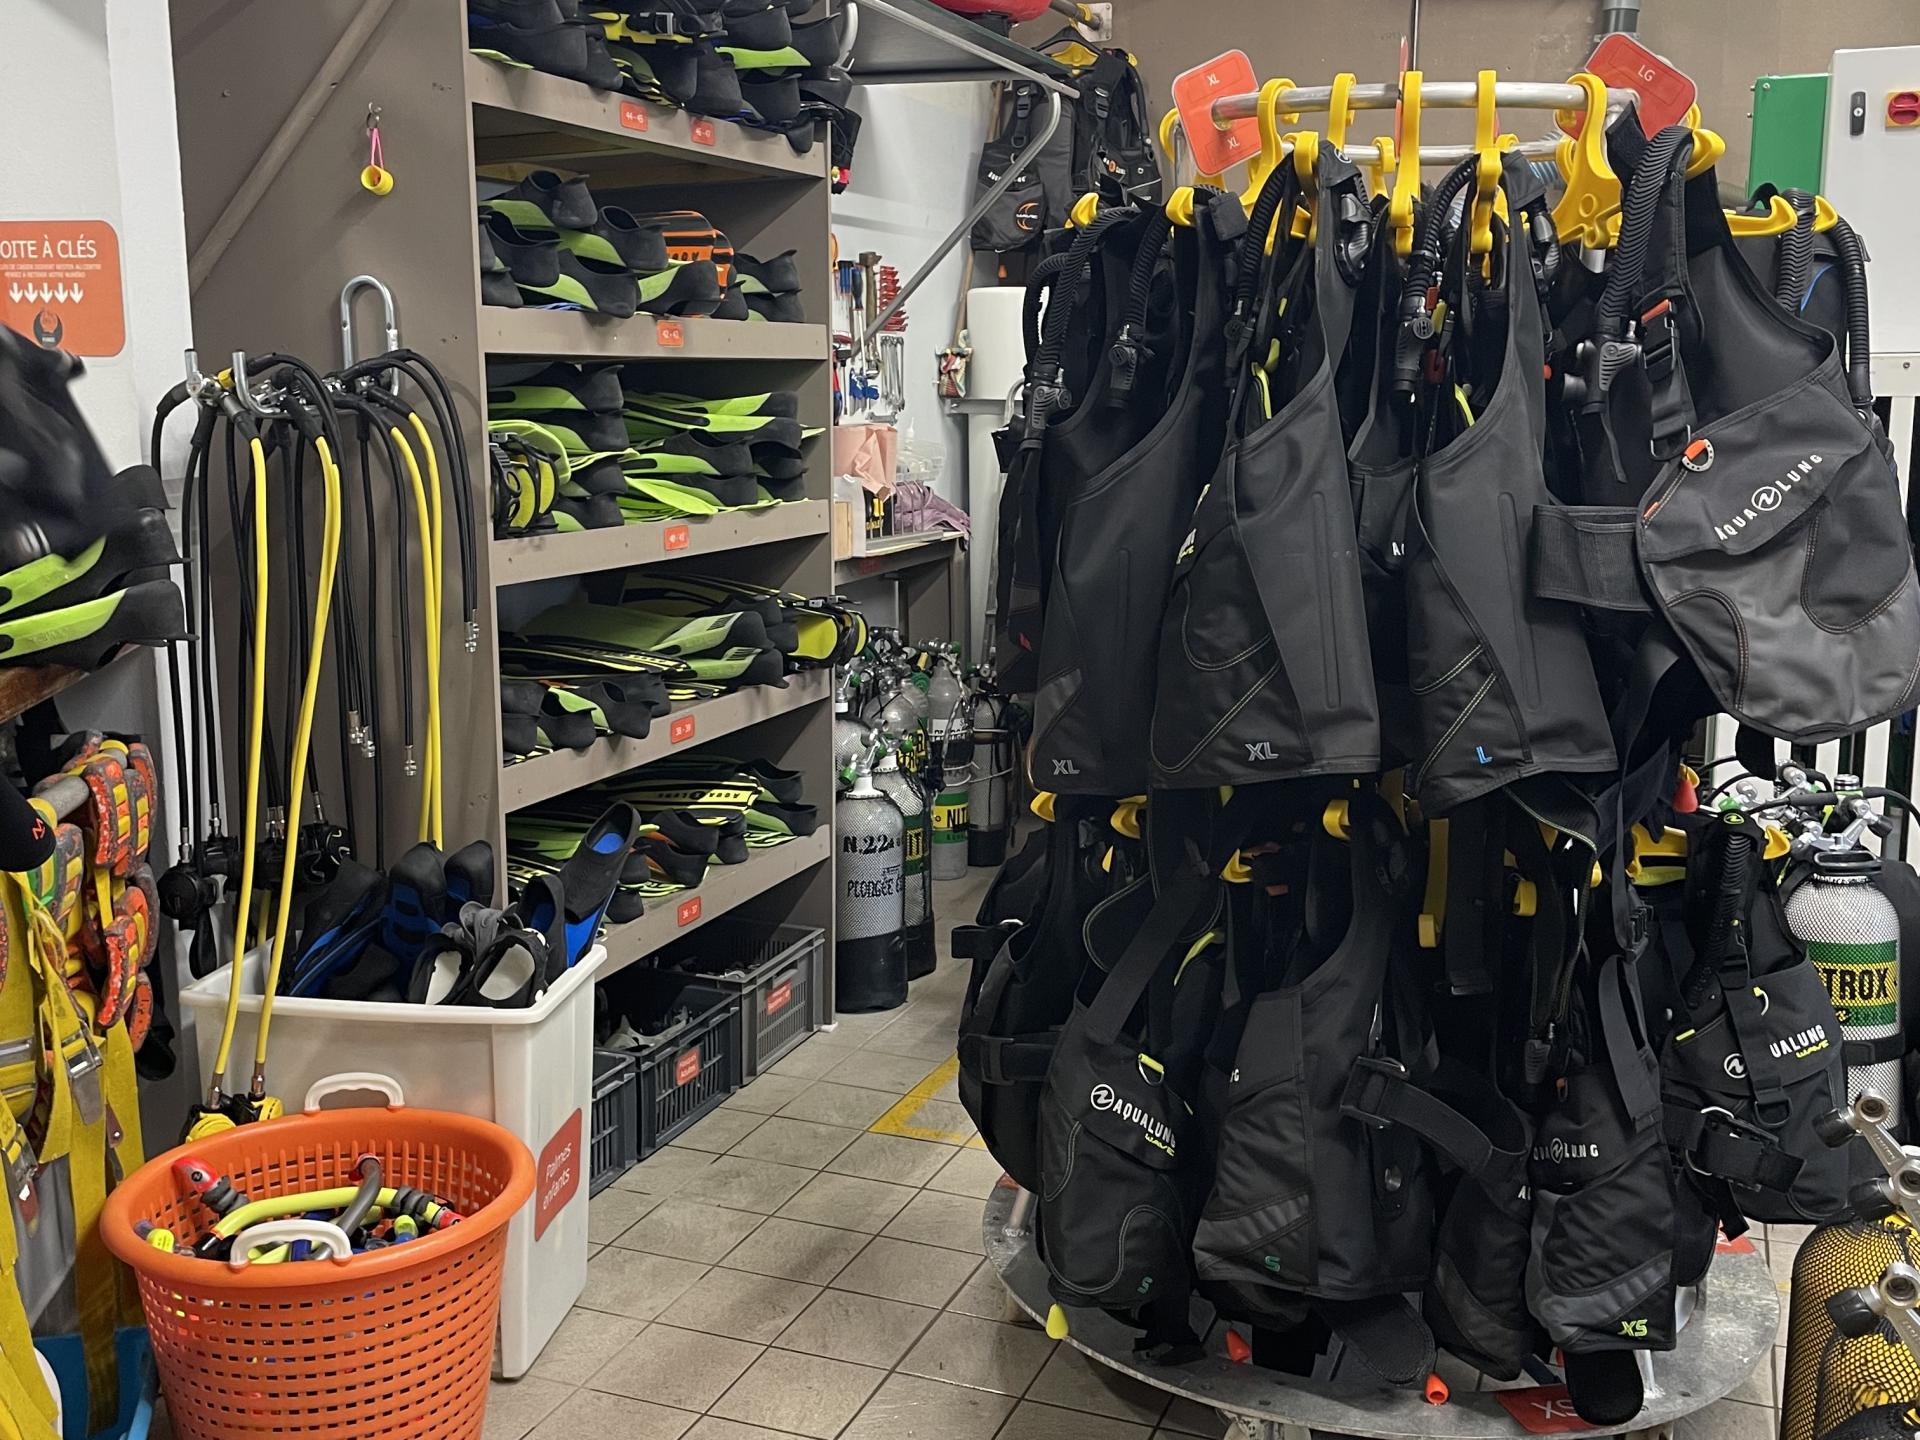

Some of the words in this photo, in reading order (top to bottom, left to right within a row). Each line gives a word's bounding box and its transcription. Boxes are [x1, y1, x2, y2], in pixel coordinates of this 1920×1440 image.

[1206, 71, 1220, 87] XL
[1638, 64, 1656, 82] LG
[1226, 135, 1240, 150] XL
[42, 234, 53, 258] À
[57, 234, 97, 258] CLÉS
[1714, 508, 1758, 540] AQUA
[1774, 454, 1823, 492] LUNG
[1245, 741, 1280, 762] XL
[1475, 745, 1493, 765] L
[1052, 759, 1081, 776] XL
[1112, 1098, 1176, 1149] AQUALUNG
[1564, 1142, 1599, 1158] LUNG
[545, 1142, 572, 1183] Palmes
[543, 1168, 571, 1210] enfants
[1264, 1255, 1281, 1272] S
[1617, 1318, 1648, 1337] XS
